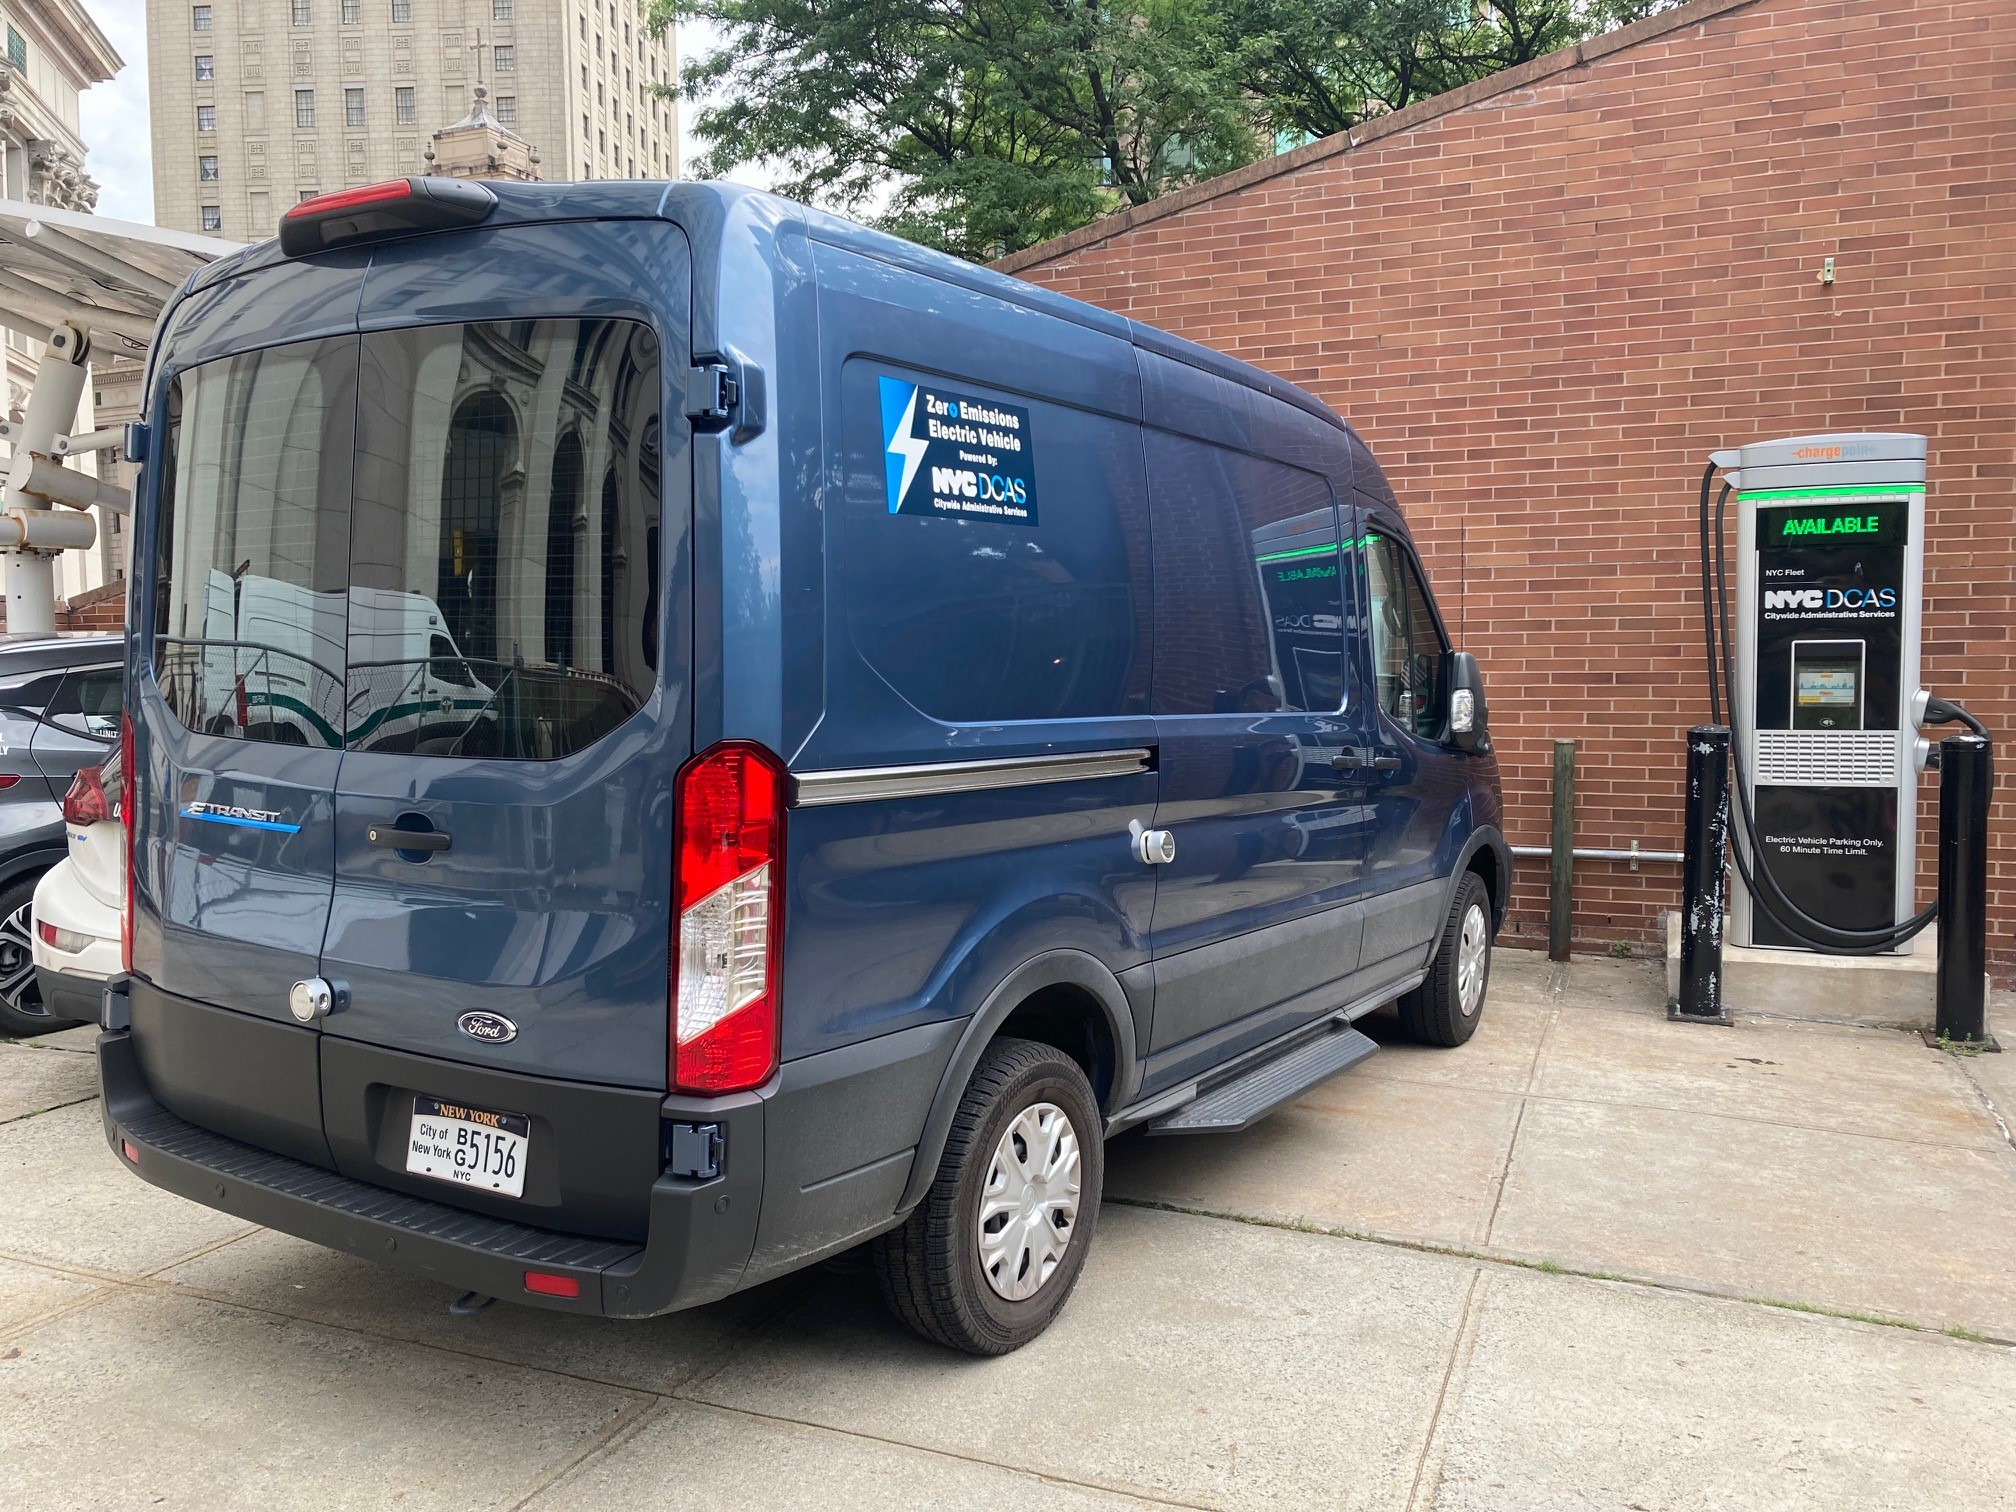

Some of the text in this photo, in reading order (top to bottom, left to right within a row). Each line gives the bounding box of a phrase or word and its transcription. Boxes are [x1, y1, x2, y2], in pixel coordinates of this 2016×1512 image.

[926, 394, 1020, 430] Zero Emissions
[928, 418, 1021, 452] Electric Vehicle
[959, 449, 998, 466] Powered By:
[931, 466, 1027, 504] NYC DCAS
[933, 497, 1028, 518] Citywide Administrative Services
[1782, 516, 1879, 536] AVAILABLE
[1765, 568, 1805, 576] NYC Fleet
[1764, 588, 1896, 609] NYC DCAS
[1764, 610, 1896, 621] Citywide Administrative Services
[1765, 835, 1884, 848] Electric Vehicle Parking Only.
[1780, 845, 1868, 856] 60 Minute Time Limit.
[468, 1016, 501, 1038] Ford
[440, 1103, 500, 1128] NEW YORK
[420, 1123, 449, 1140] City of
[411, 1139, 452, 1160] New York
[453, 1169, 472, 1182] NYC
